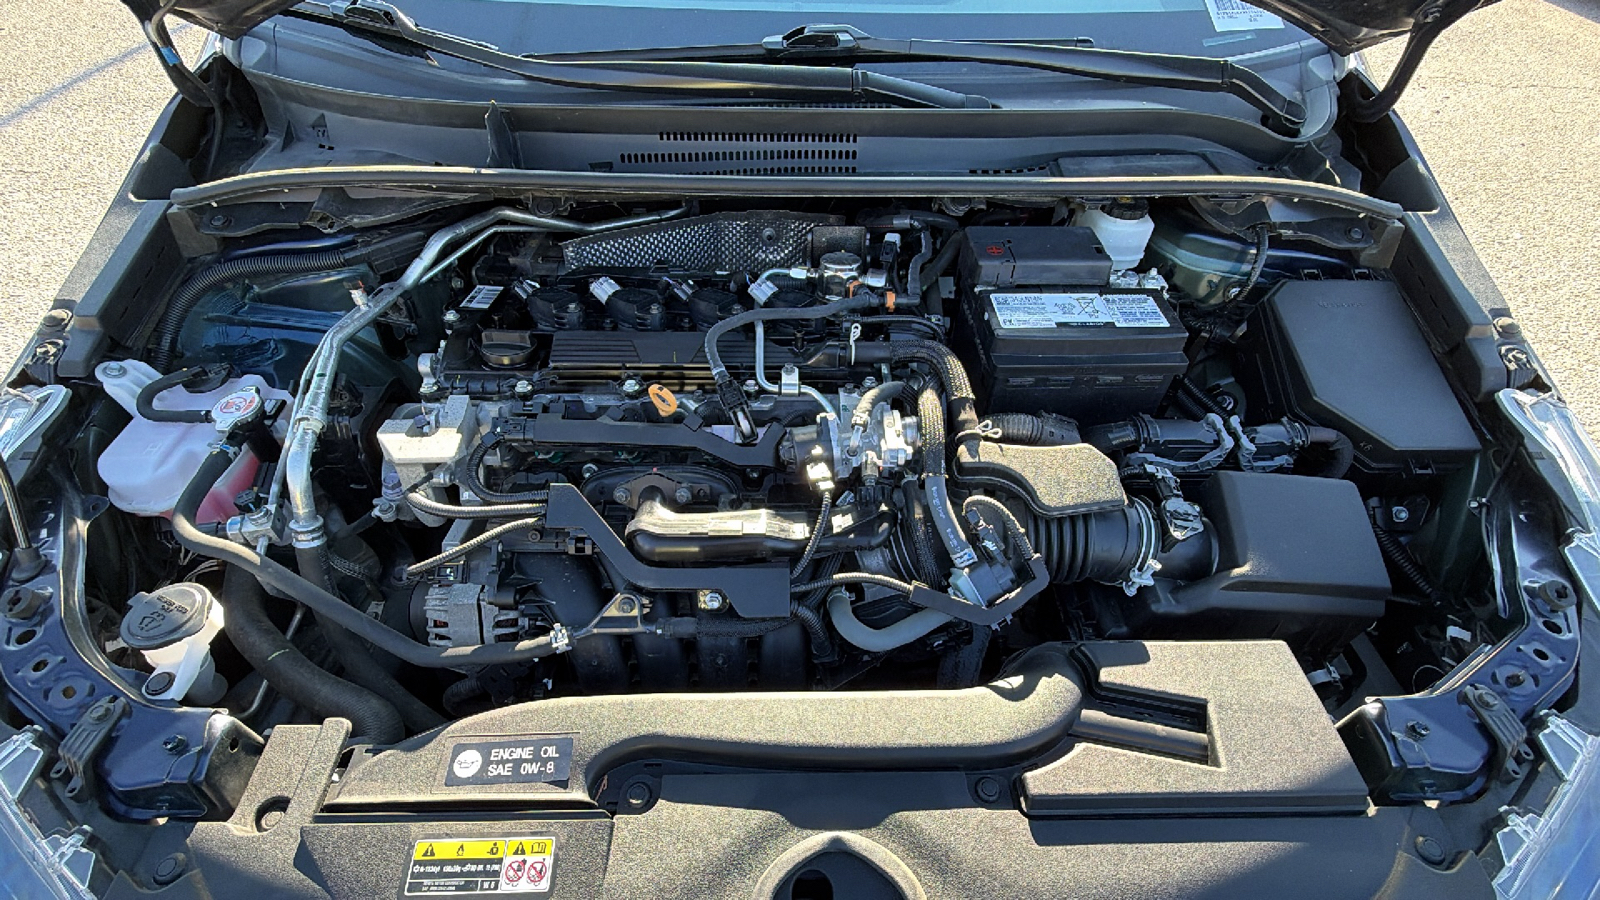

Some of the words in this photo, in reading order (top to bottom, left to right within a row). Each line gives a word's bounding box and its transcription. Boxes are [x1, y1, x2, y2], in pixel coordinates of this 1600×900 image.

[490, 746, 534, 761] ENGINE
[541, 745, 559, 758] OIL
[487, 763, 513, 776] SAE
[520, 761, 554, 775] 0W-8
